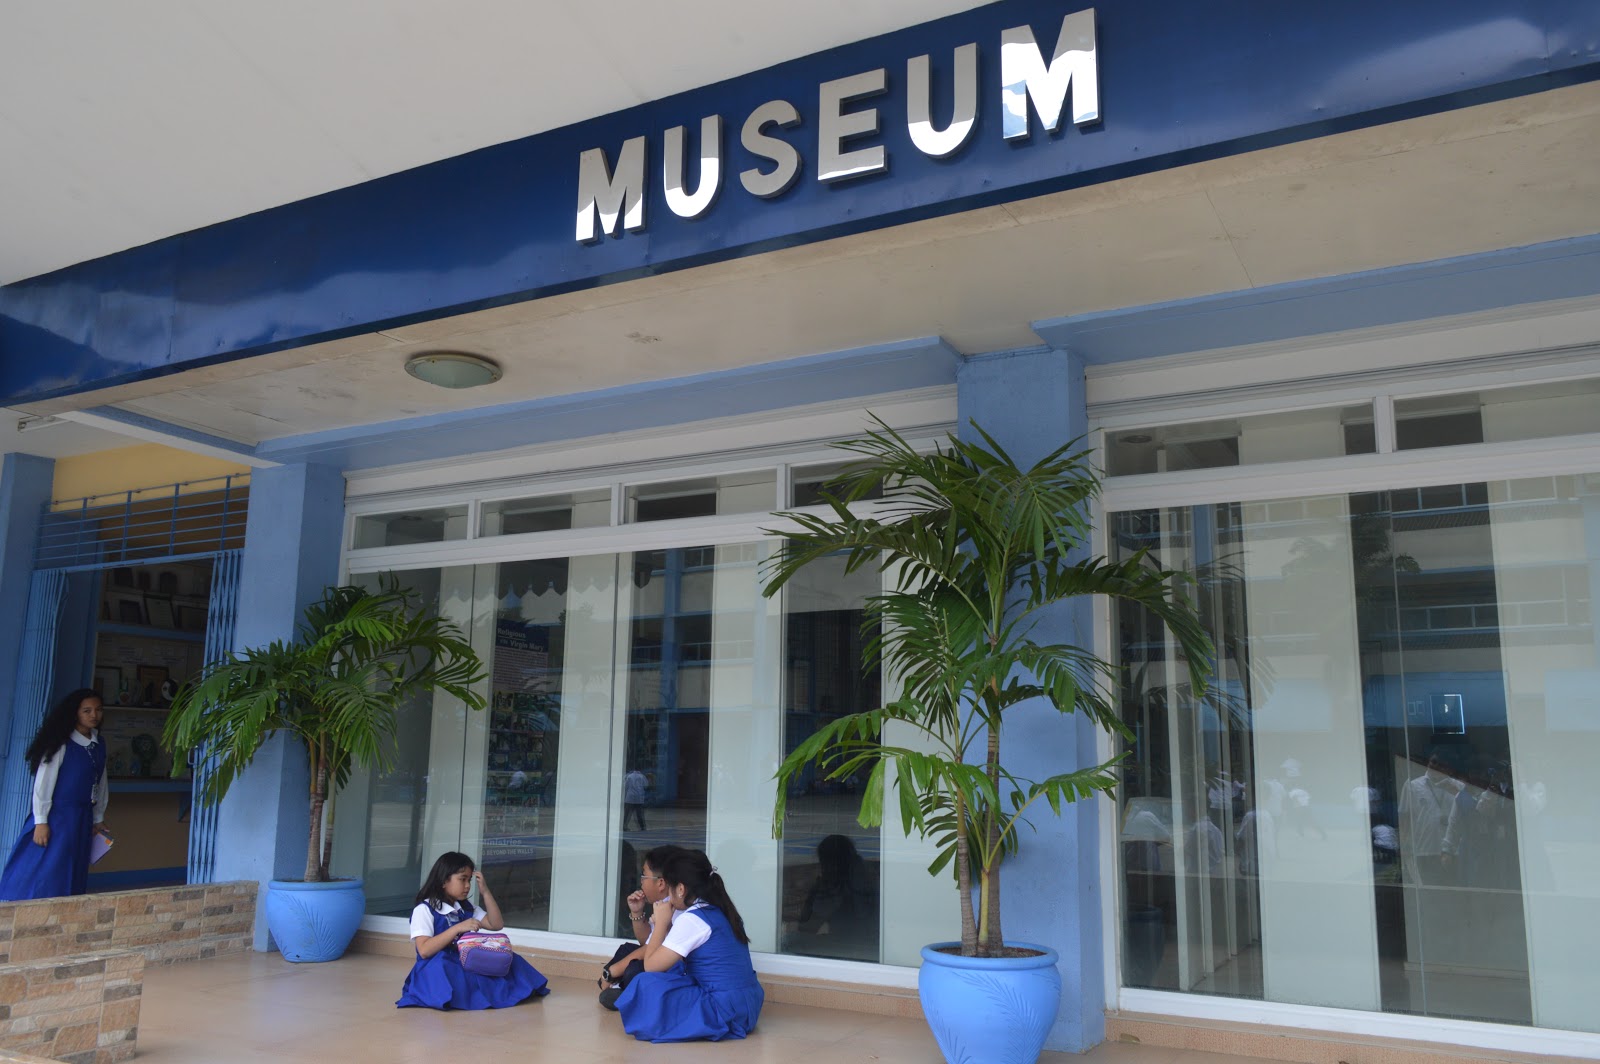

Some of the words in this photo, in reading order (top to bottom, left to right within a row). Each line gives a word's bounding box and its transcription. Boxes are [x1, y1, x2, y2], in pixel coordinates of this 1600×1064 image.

[576, 8, 1101, 242] MUSEUM
[498, 628, 526, 638] Religious
[510, 640, 527, 650] Virgin
[529, 642, 544, 652] Mary
